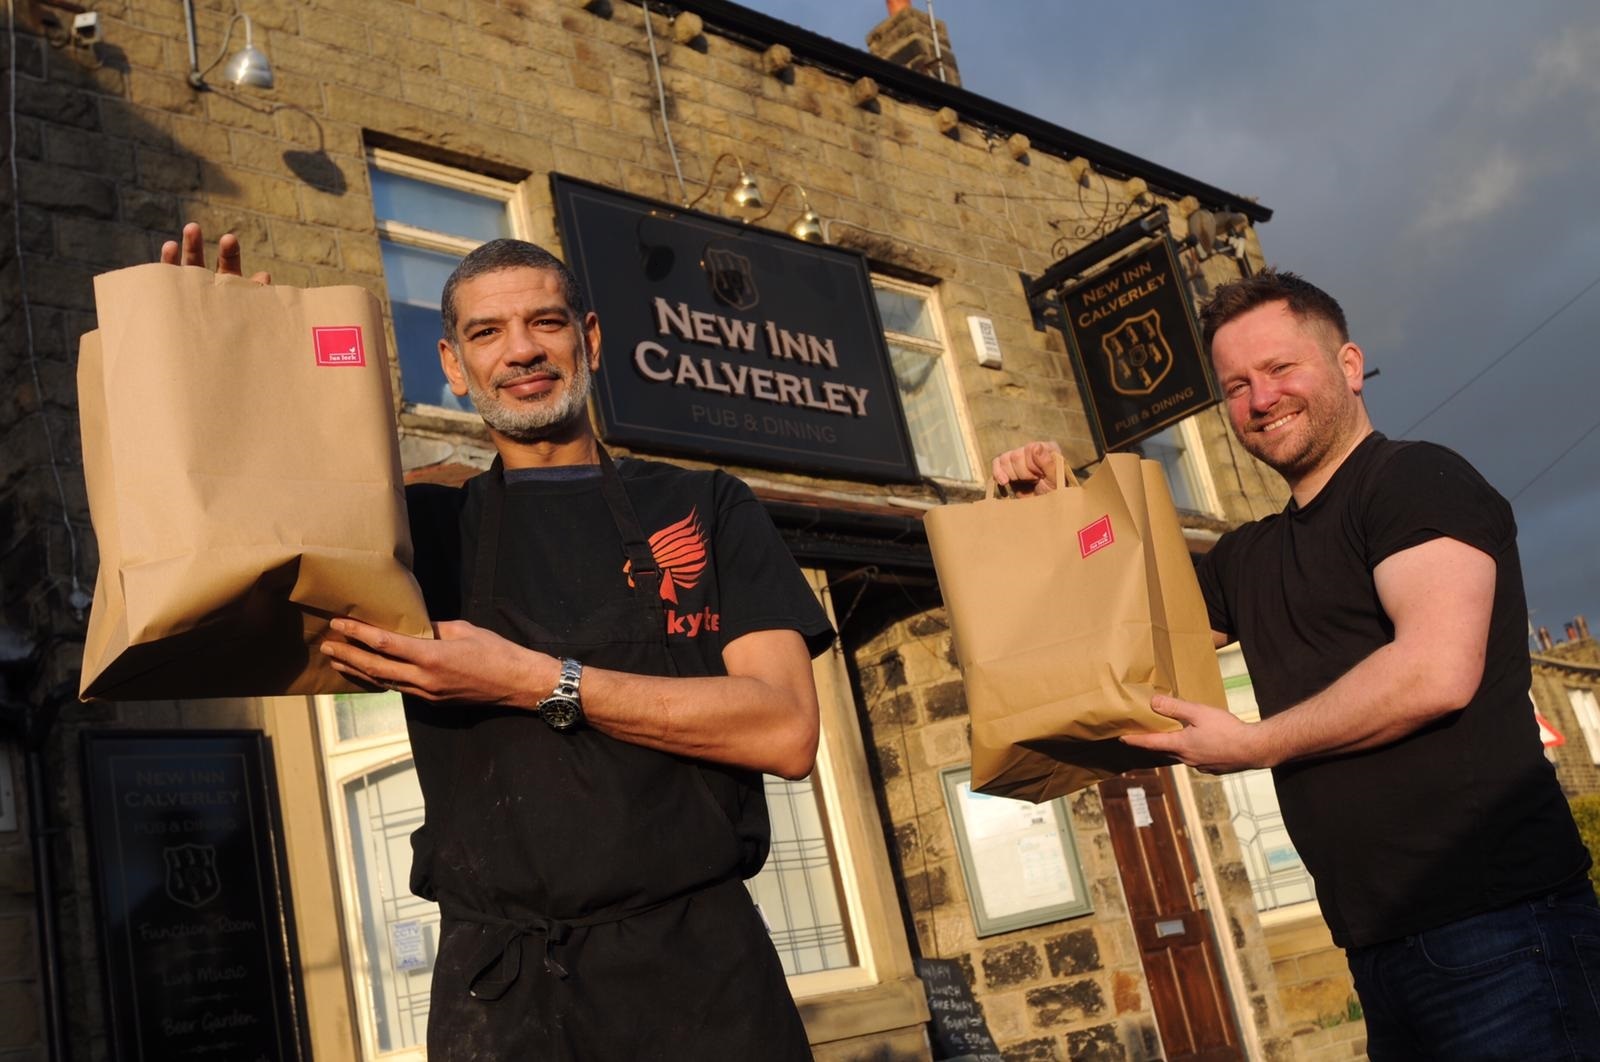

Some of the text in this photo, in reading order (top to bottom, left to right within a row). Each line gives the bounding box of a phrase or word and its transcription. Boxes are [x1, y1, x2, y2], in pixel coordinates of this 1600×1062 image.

[1078, 272, 1167, 328] CALVERLEY
[1081, 261, 1153, 307] NEW INN
[653, 296, 839, 369] NEW INN
[633, 341, 870, 417] CALVERLEY
[691, 404, 838, 443] PUB & DINING
[1114, 387, 1195, 433] PUB & DINING
[124, 788, 241, 808] CALVERLEY
[136, 768, 226, 787] NEW INN
[138, 920, 209, 942] Function
